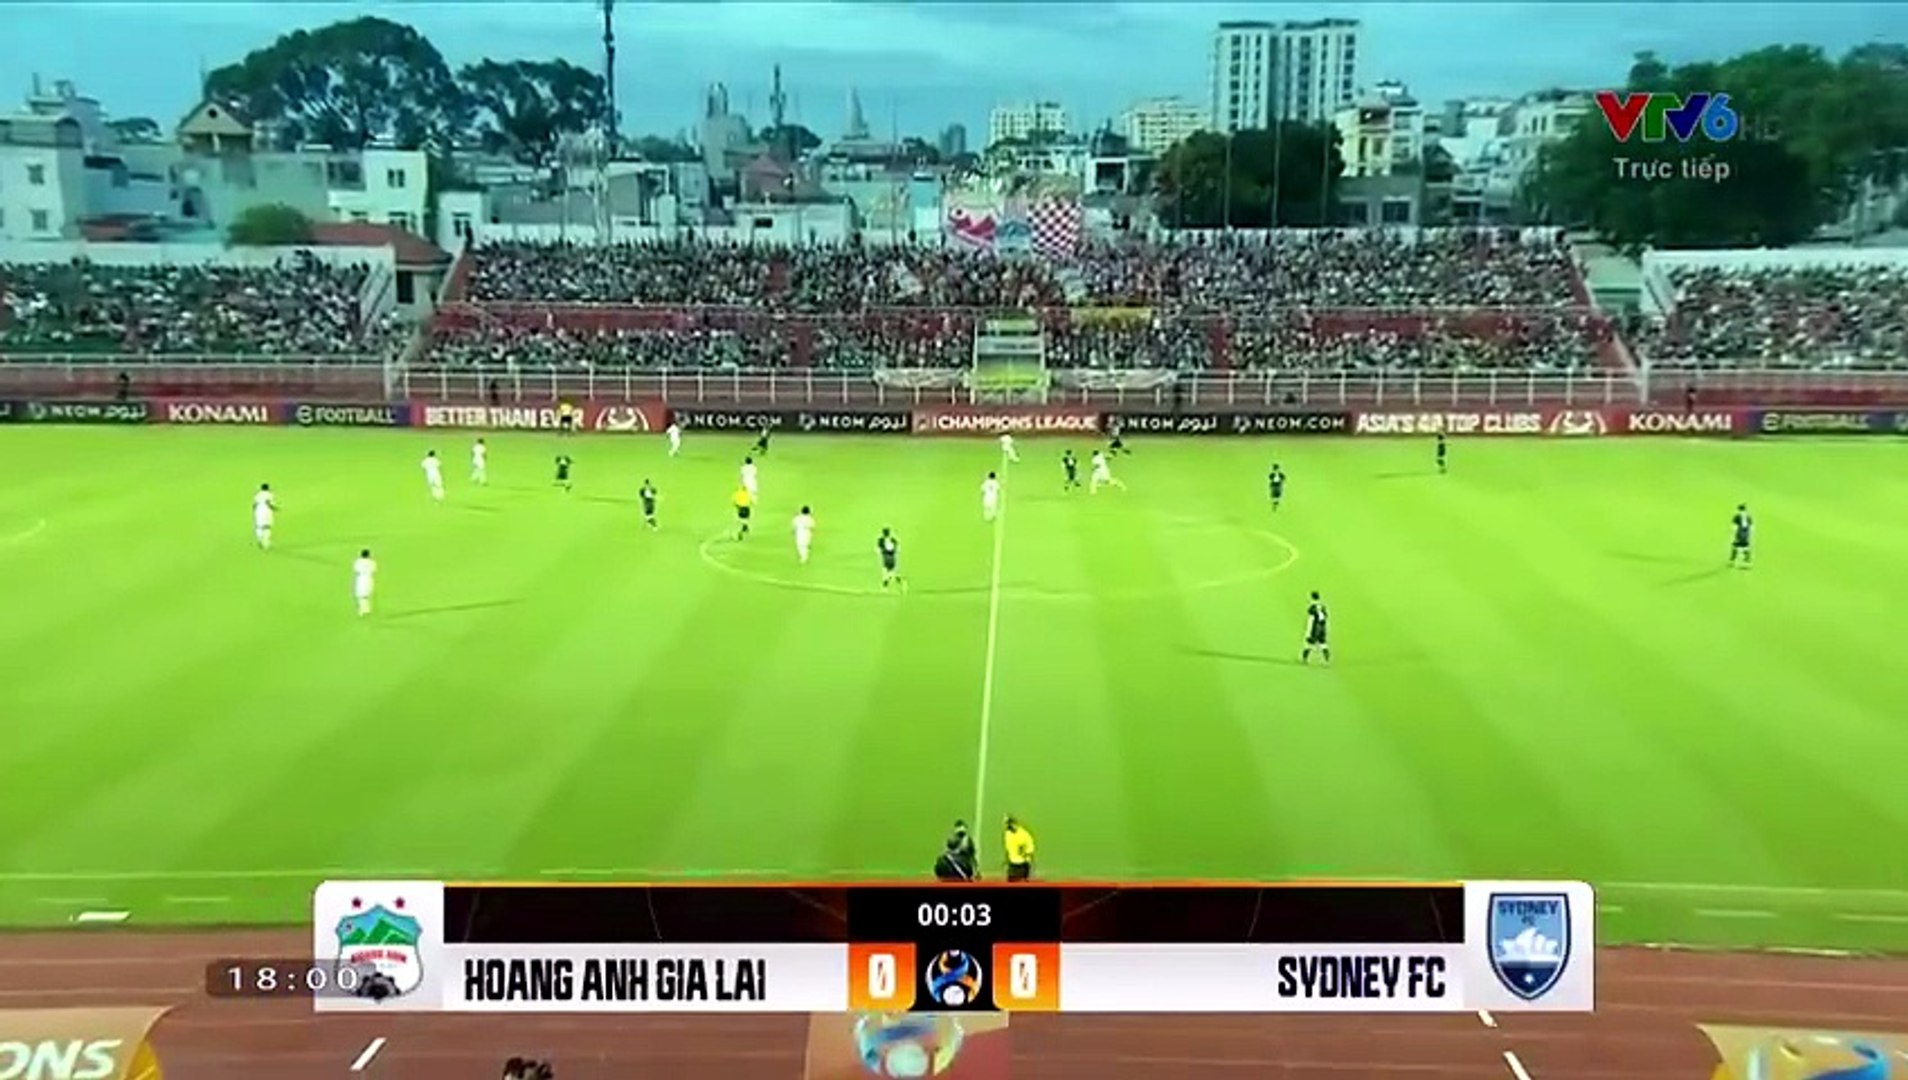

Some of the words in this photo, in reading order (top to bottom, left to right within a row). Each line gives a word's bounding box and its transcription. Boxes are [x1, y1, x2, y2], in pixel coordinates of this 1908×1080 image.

[168, 404, 268, 422] KONAMI
[425, 407, 486, 426] BETTER
[489, 408, 536, 427] THAN
[540, 408, 584, 428] EVR
[819, 415, 863, 428] NEOM
[1035, 415, 1097, 430] LEAGUE
[1129, 417, 1174, 429] NEOM
[1356, 413, 1414, 433] ASIA'S
[1447, 414, 1480, 433] TOP
[1483, 413, 1542, 433] CLUBS
[1629, 414, 1732, 430] KONAMI
